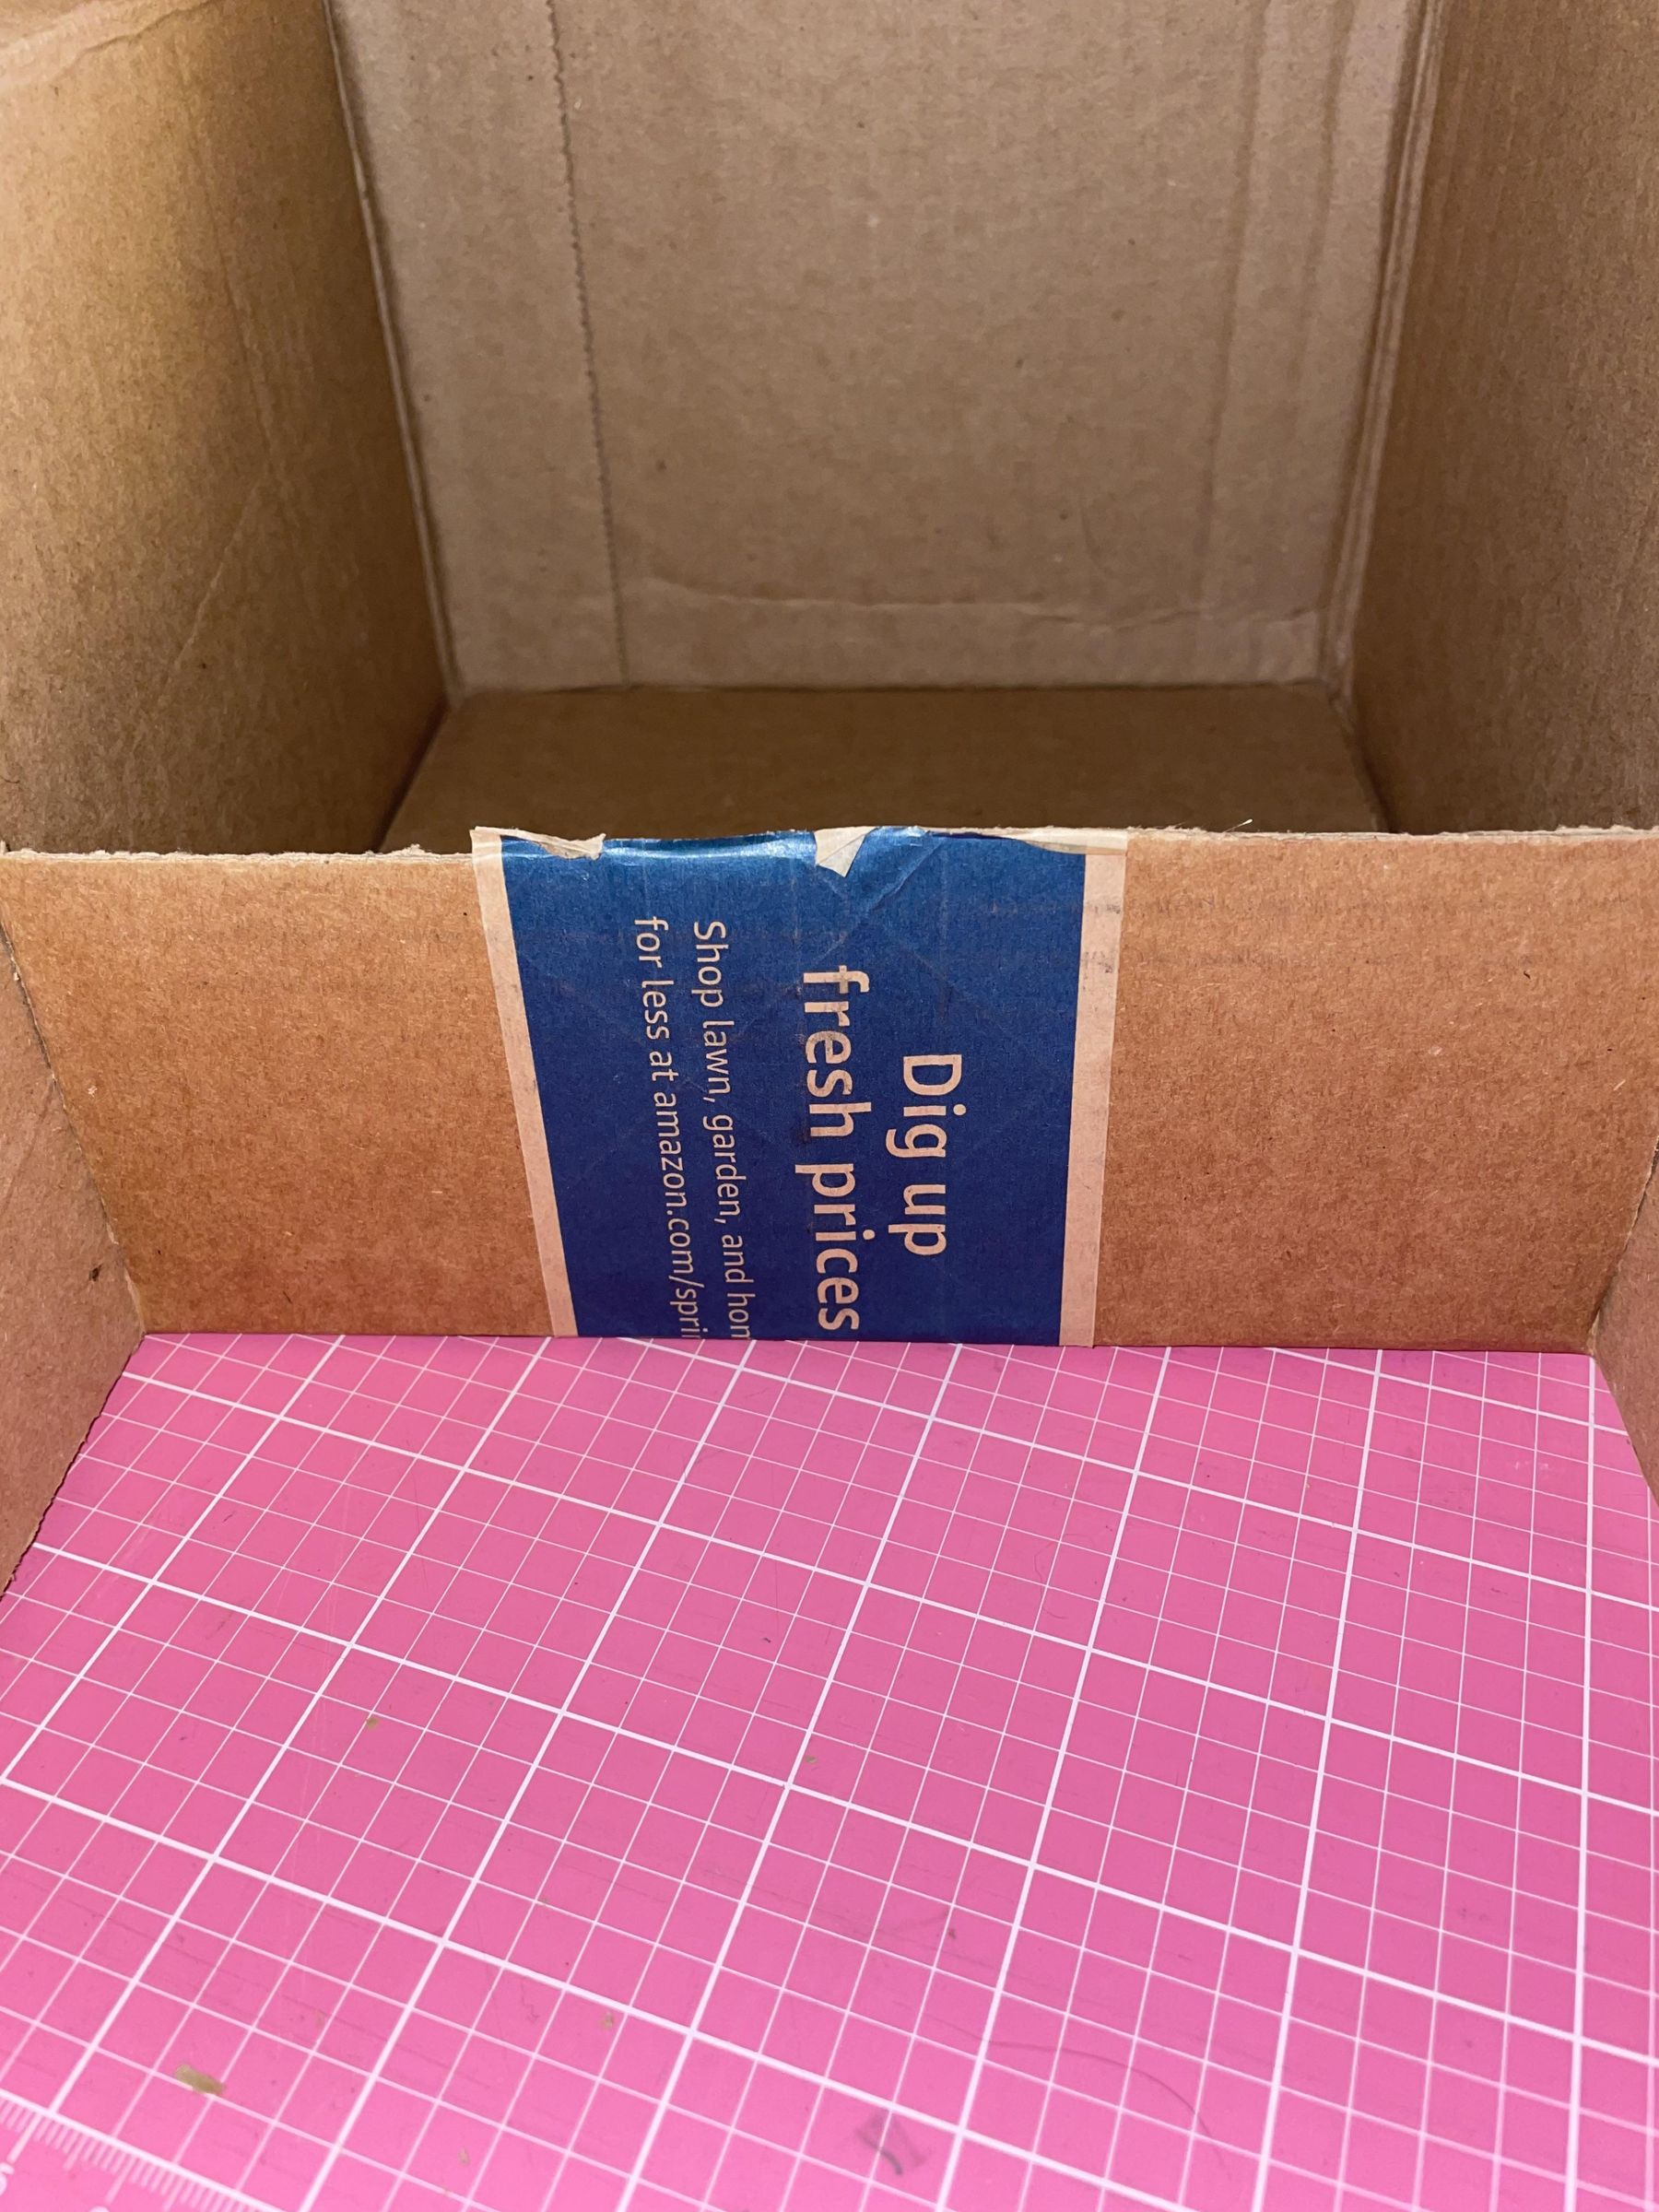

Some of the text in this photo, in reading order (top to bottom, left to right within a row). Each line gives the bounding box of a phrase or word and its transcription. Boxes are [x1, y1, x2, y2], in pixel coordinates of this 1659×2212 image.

[691, 921, 729, 1007] Shop
[702, 1020, 735, 1103] lawn,
[634, 916, 709, 1338] for less at amazon.com/spri
[702, 1113, 747, 1224] garden,
[794, 965, 876, 1330] fresh prices
[886, 1053, 967, 1255] Dig up
[723, 1234, 754, 1283] and
